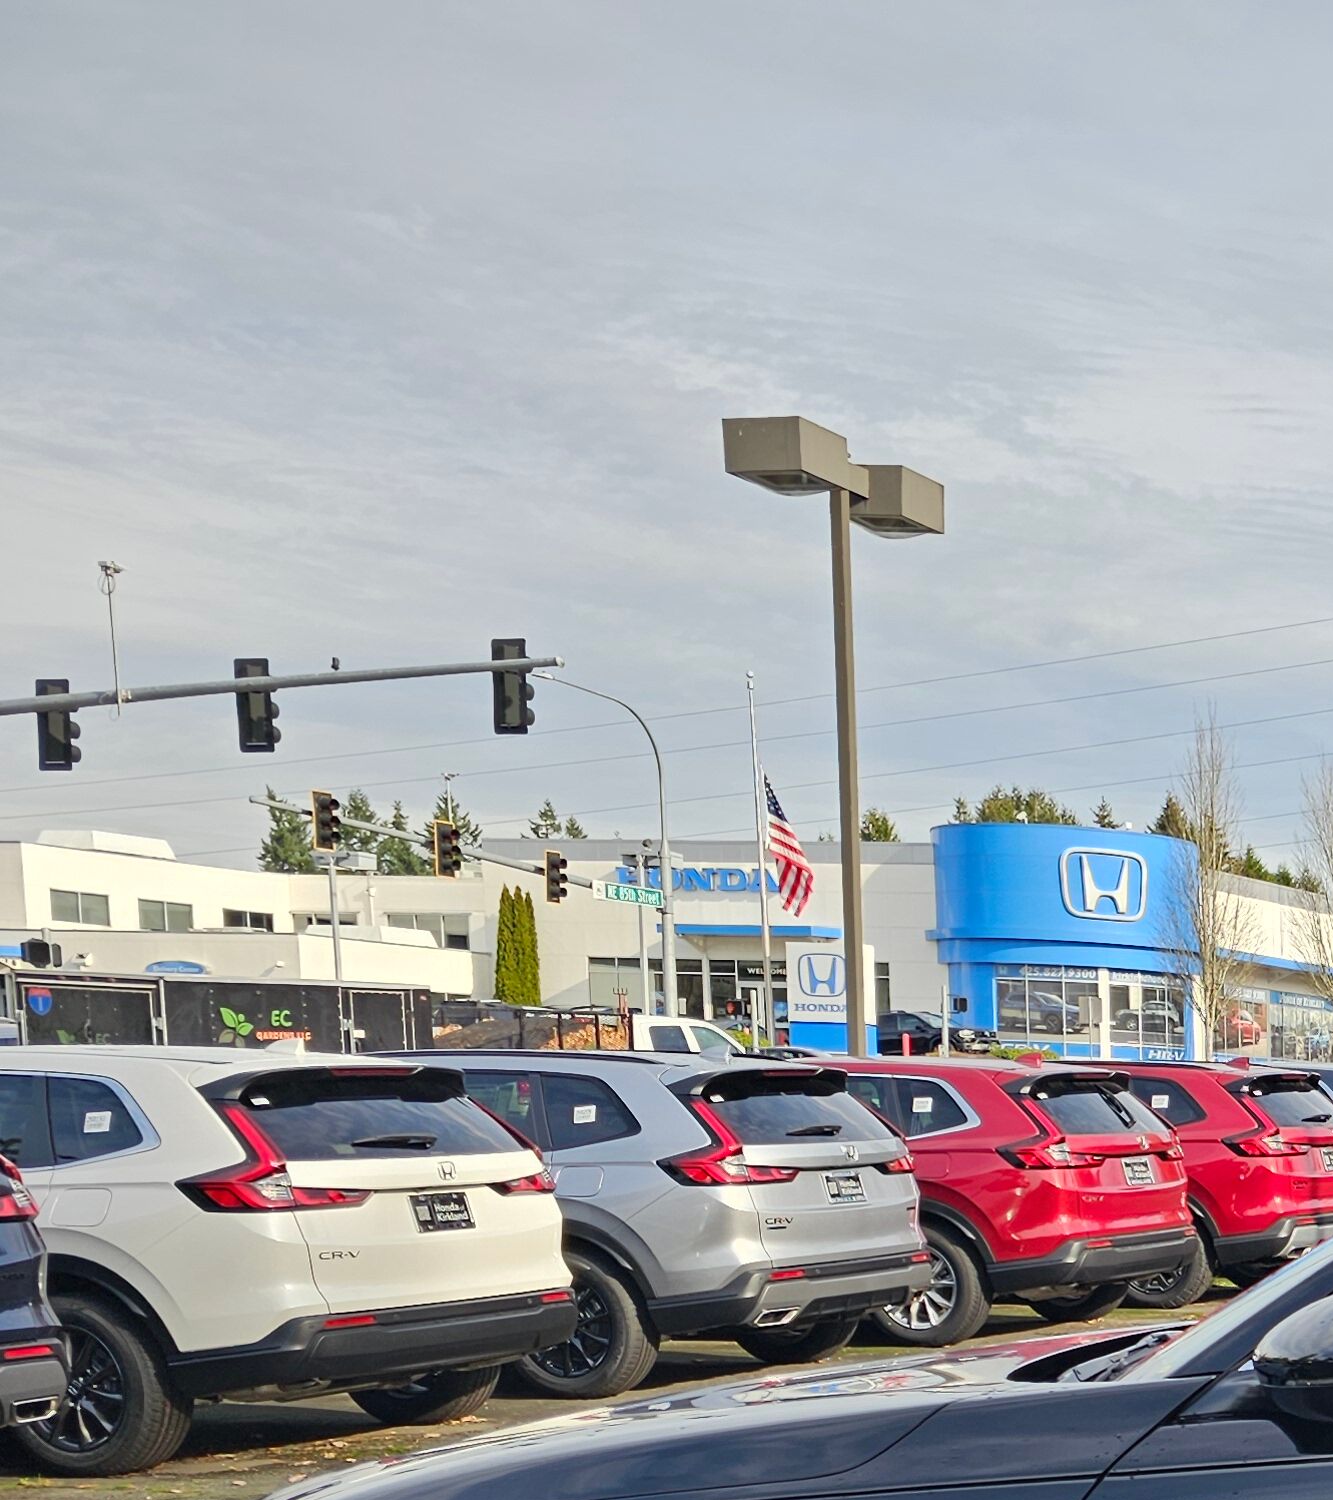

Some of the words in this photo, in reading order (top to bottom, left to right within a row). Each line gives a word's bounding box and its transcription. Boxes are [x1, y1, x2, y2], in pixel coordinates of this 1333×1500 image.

[615, 866, 781, 893] HONDA
[607, 885, 618, 899] NE
[638, 889, 660, 906] Street
[747, 967, 786, 975] WELOME
[271, 1010, 293, 1027] EC
[434, 1202, 459, 1212] Honda
[436, 1211, 469, 1222] Kirkland
[765, 1217, 793, 1225] CR-V
[319, 1250, 361, 1260] CR-V
